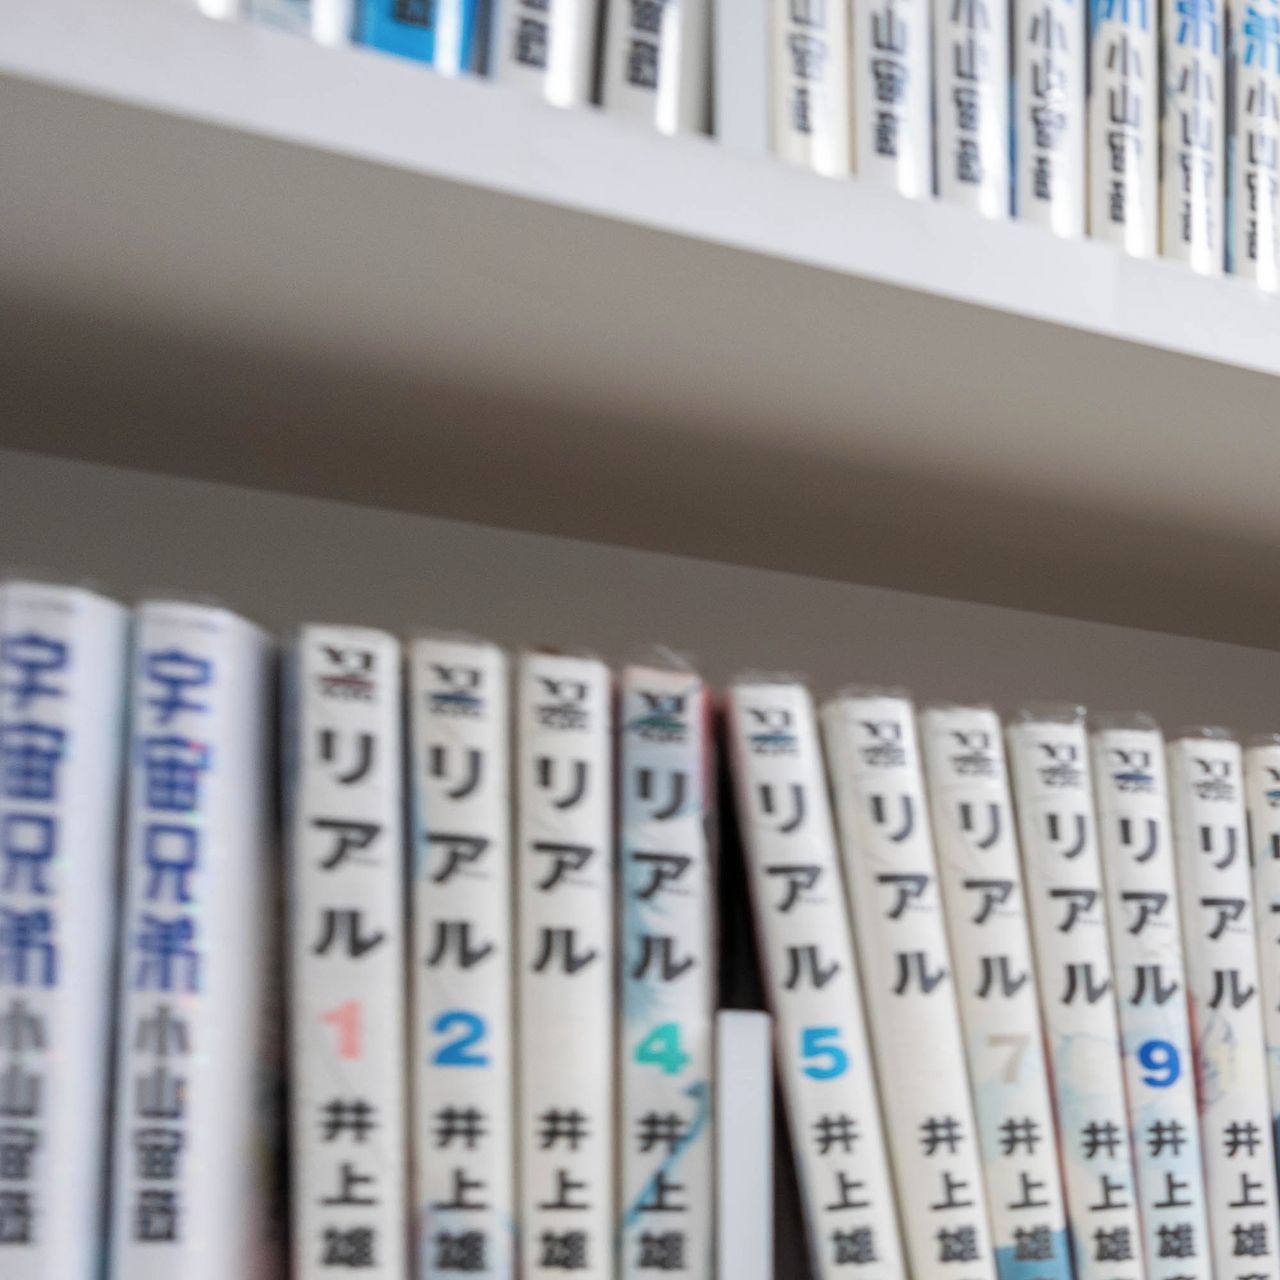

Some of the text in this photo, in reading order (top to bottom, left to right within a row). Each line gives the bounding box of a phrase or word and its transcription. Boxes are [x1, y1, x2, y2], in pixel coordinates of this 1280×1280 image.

[137, 650, 213, 993] 宇宙兄弟
[312, 729, 385, 962] リアル
[426, 745, 494, 971] リアル
[534, 757, 596, 976] リアル
[634, 769, 696, 984] リアル
[761, 784, 841, 992] リアル
[872, 794, 947, 997] リアル
[959, 802, 1027, 999] リアル
[1046, 813, 1112, 1007] リアル
[1119, 816, 1179, 1009] リアル
[1202, 824, 1258, 1012] リアル
[323, 1003, 363, 1061] 1
[431, 1011, 490, 1068] 2
[634, 1023, 692, 1075] 4
[800, 1028, 851, 1081] 5
[1139, 1038, 1181, 1090] 9
